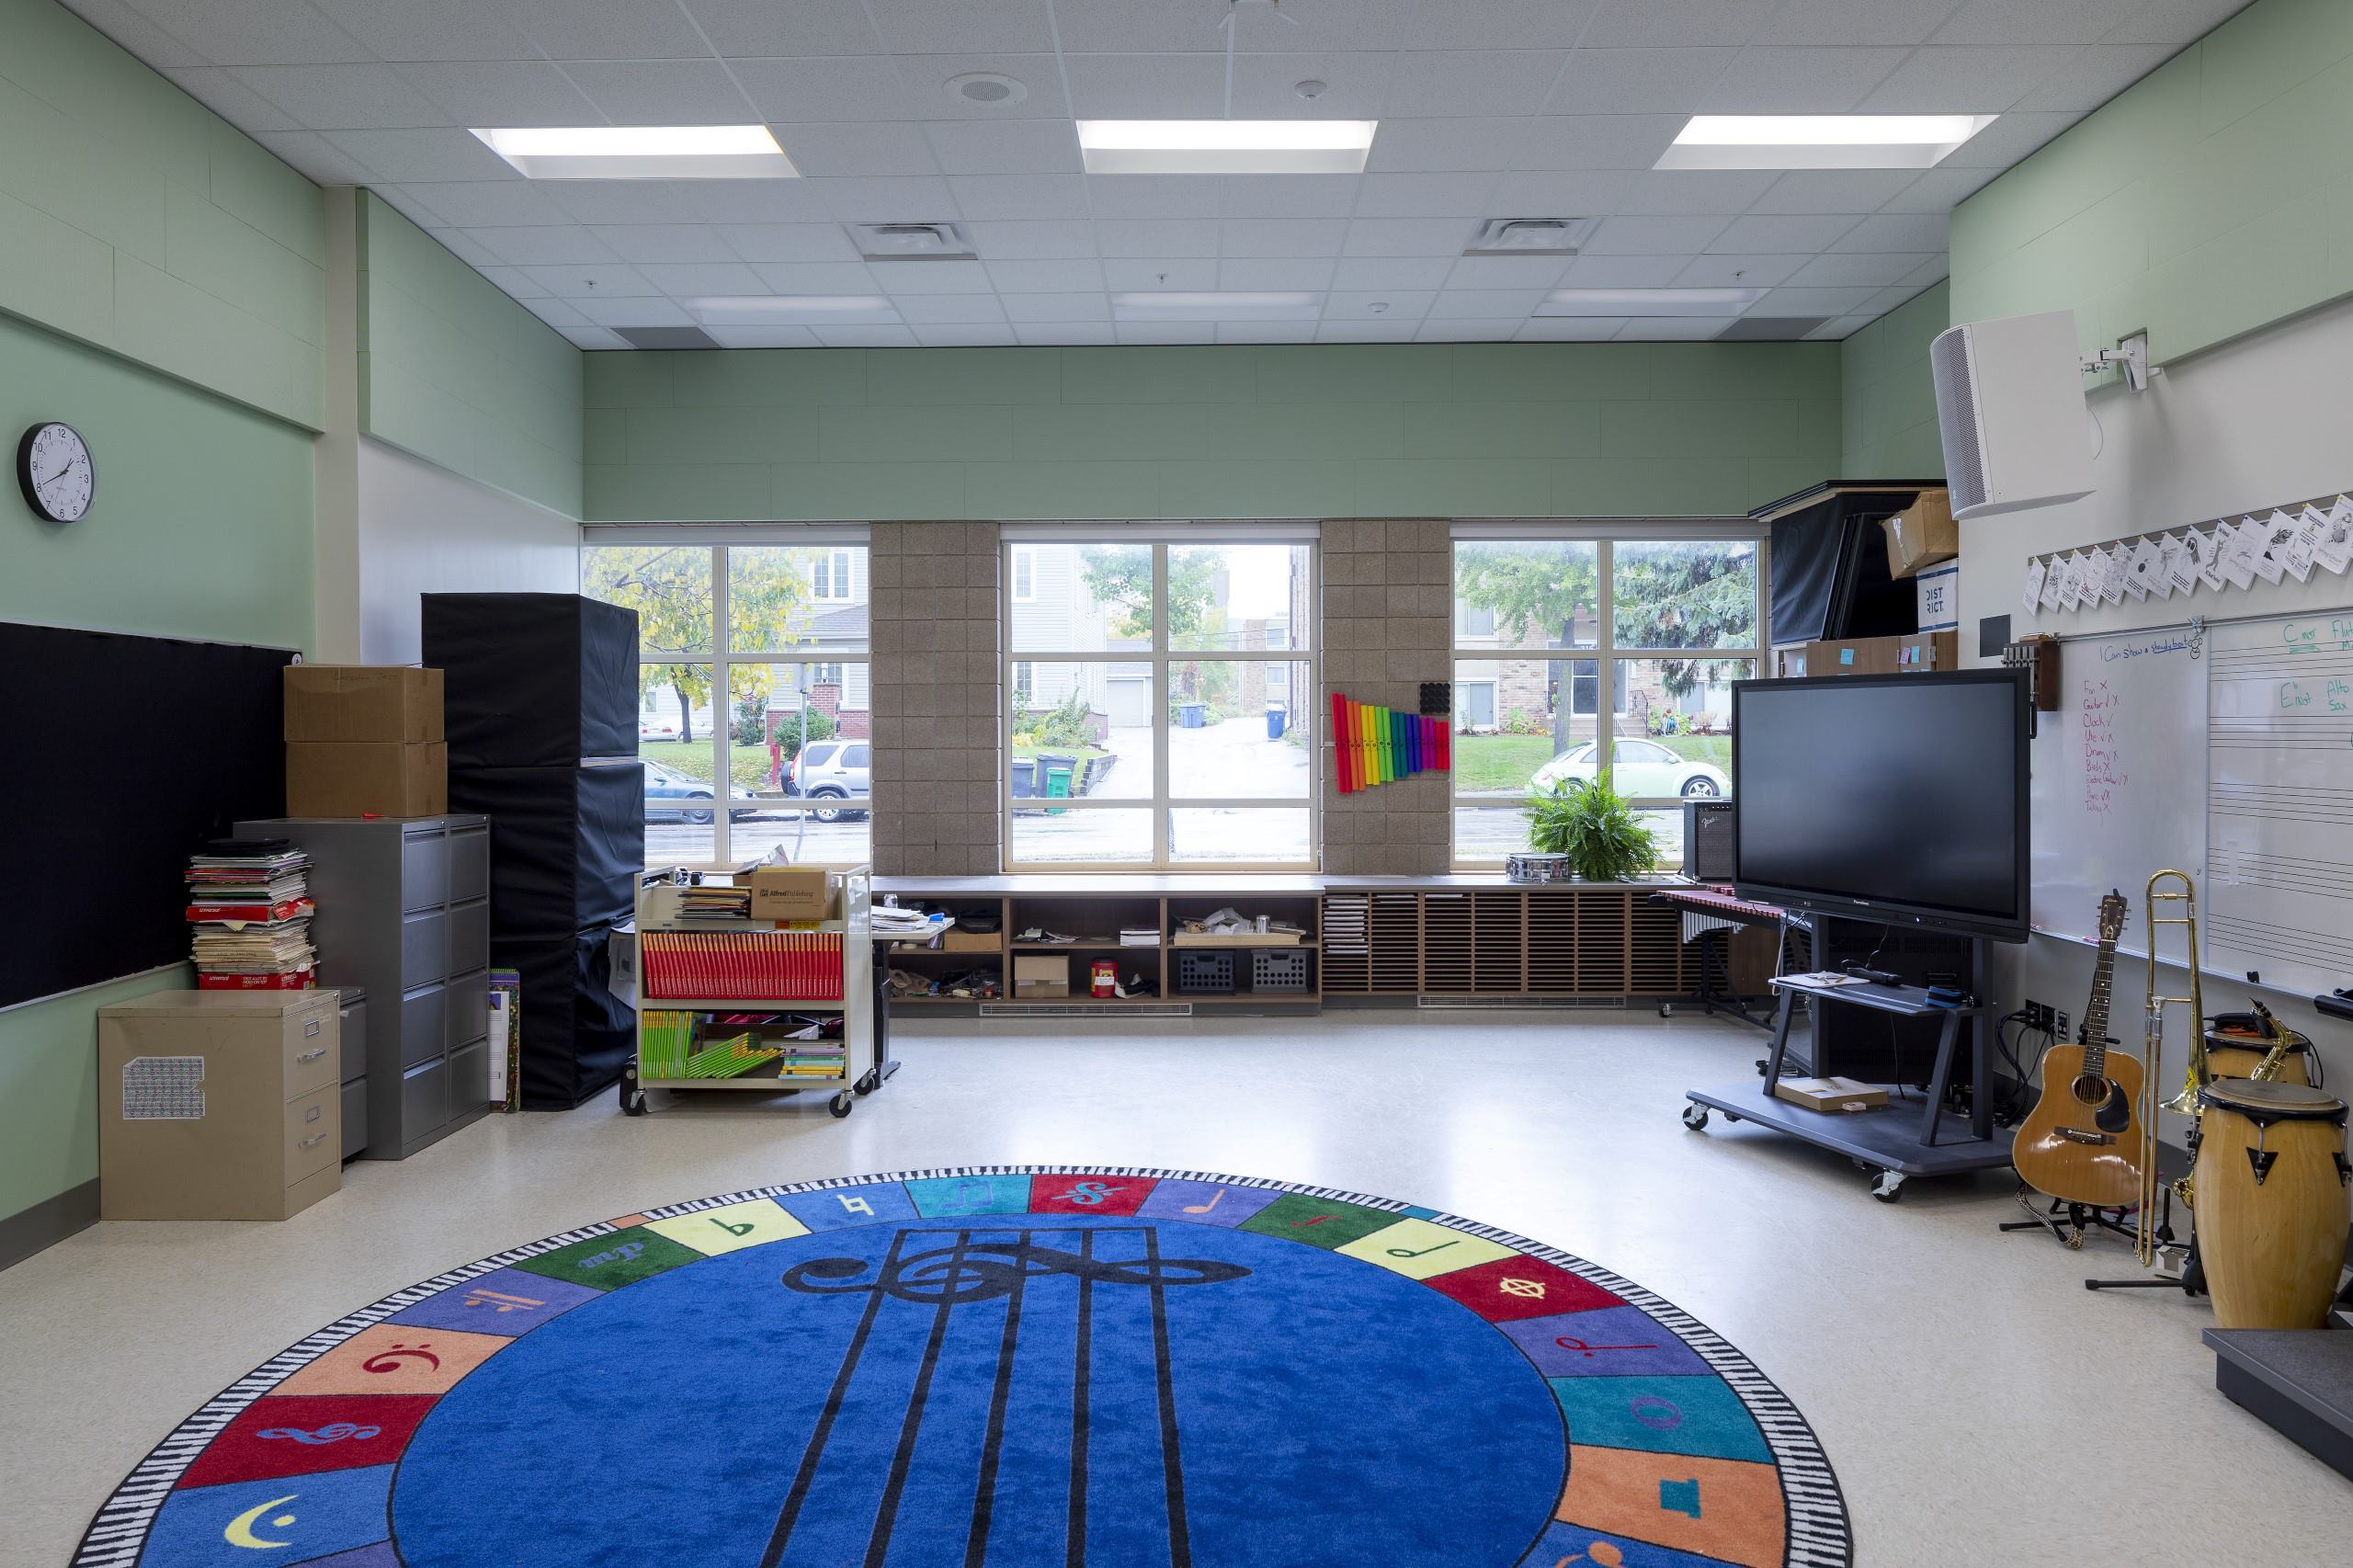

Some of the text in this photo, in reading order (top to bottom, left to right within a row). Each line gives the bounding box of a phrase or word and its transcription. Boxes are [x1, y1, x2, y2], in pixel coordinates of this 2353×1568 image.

[44, 430, 51, 440] 11
[58, 428, 66, 438] 12
[34, 442, 43, 452] 10
[82, 454, 86, 463] 2
[32, 460, 38, 471] 9
[85, 474, 89, 483] 3
[37, 483, 41, 493] 8
[82, 494, 86, 502] 4
[46, 500, 51, 510] 7
[60, 509, 64, 517] 6
[74, 506, 78, 515] 5
[769, 889, 787, 897] Alfred
